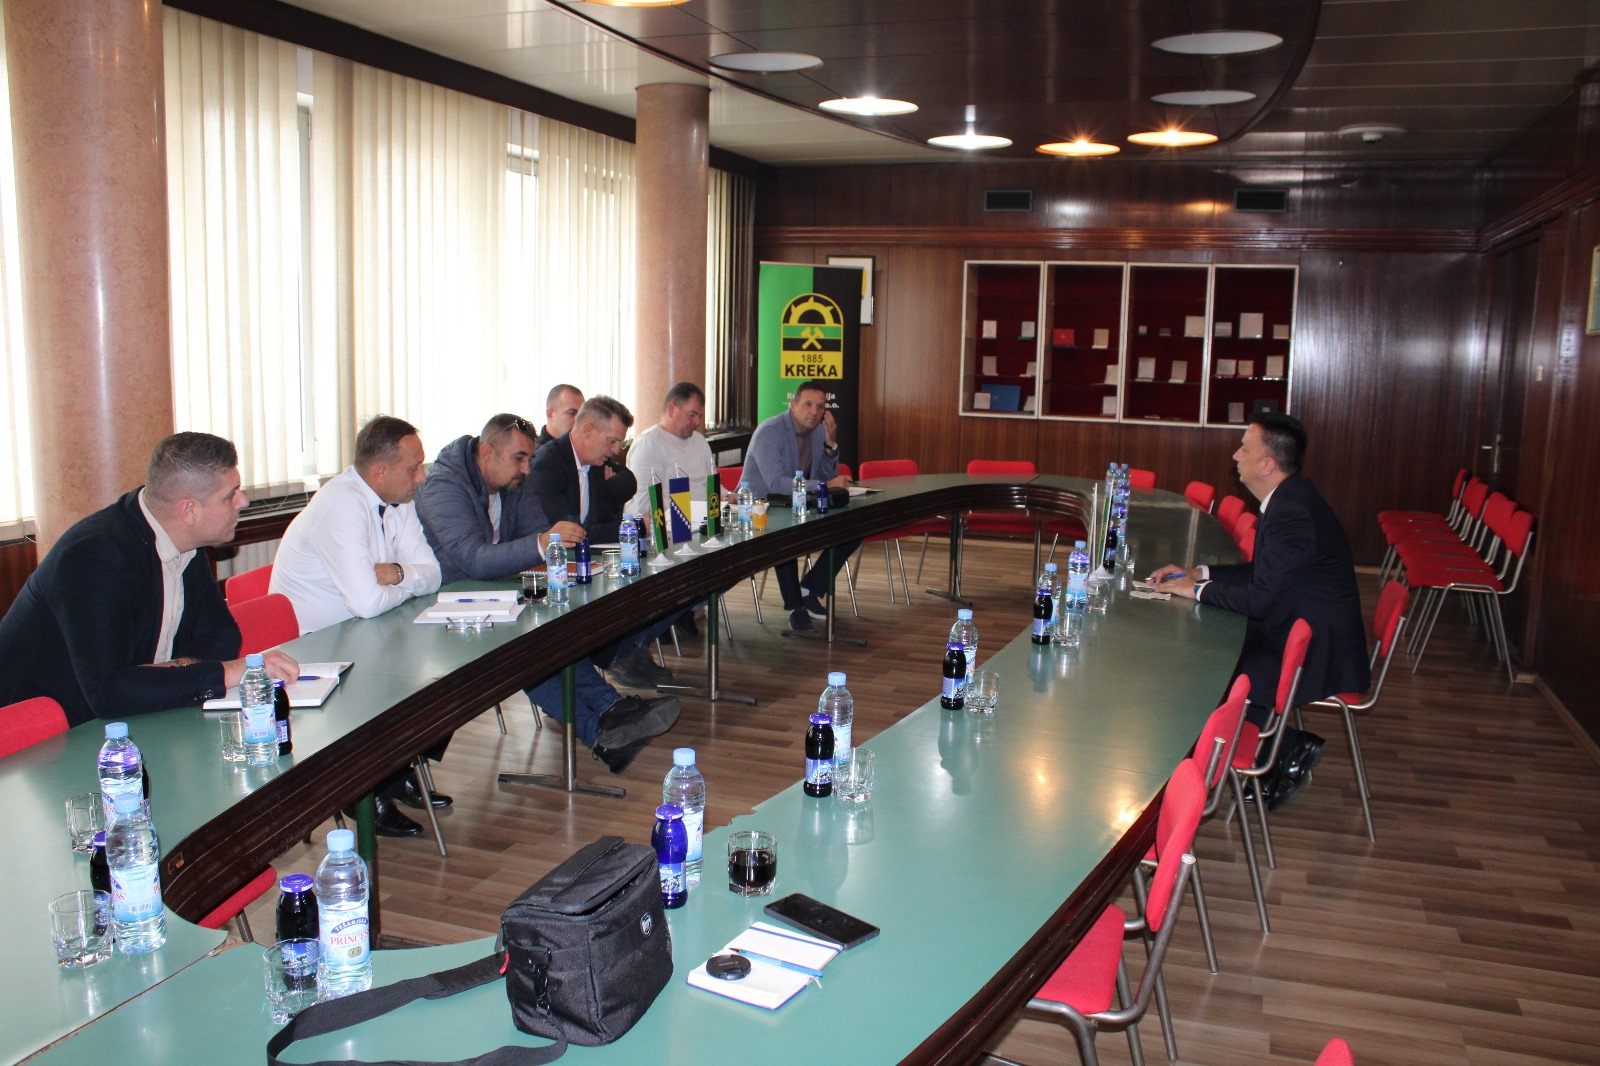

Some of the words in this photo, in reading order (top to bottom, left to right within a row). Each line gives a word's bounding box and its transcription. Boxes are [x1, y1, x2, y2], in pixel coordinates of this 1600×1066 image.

[801, 354, 823, 363] 1885
[785, 364, 838, 377] KREKA
[330, 928, 369, 945] PRINCES
